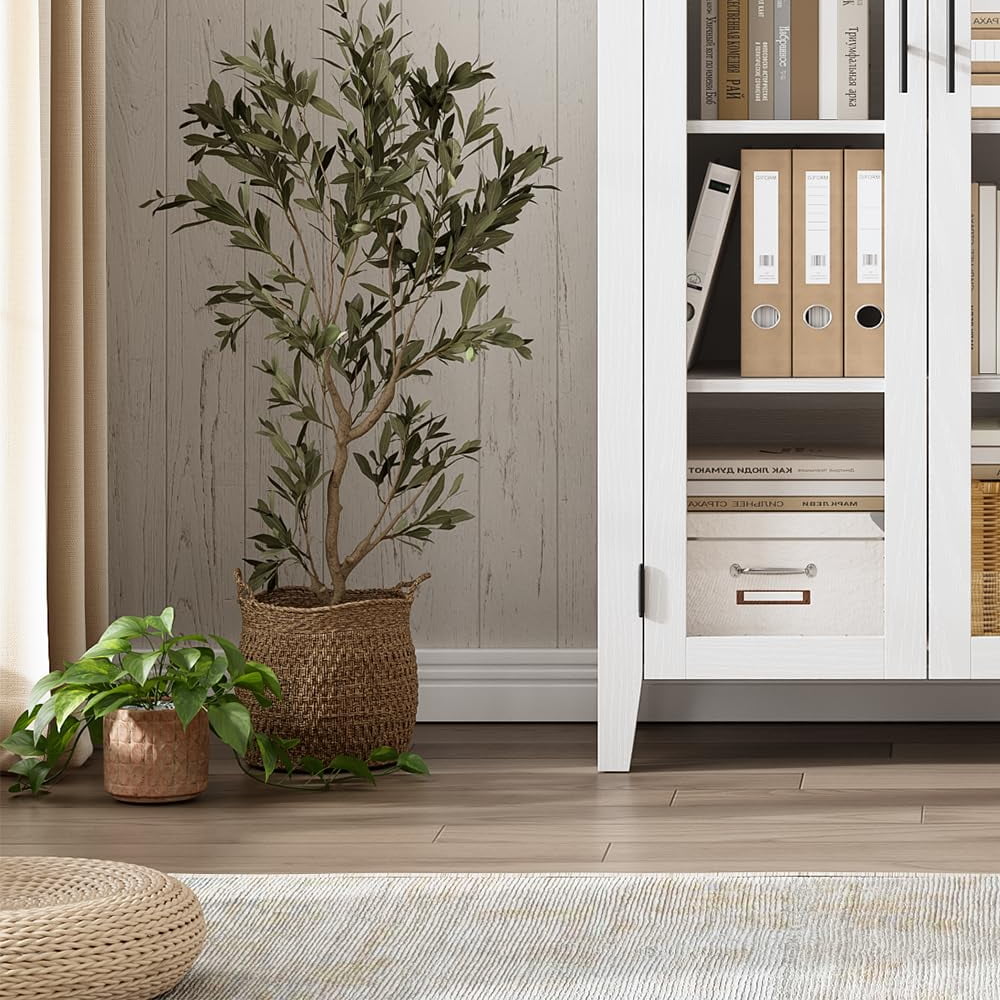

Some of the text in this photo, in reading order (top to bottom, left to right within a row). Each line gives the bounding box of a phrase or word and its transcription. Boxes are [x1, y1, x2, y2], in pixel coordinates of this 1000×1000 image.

[845, 26, 860, 107] Триумфальная арка
[706, 92, 716, 105] Боб
[726, 80, 744, 100] РАЙ
